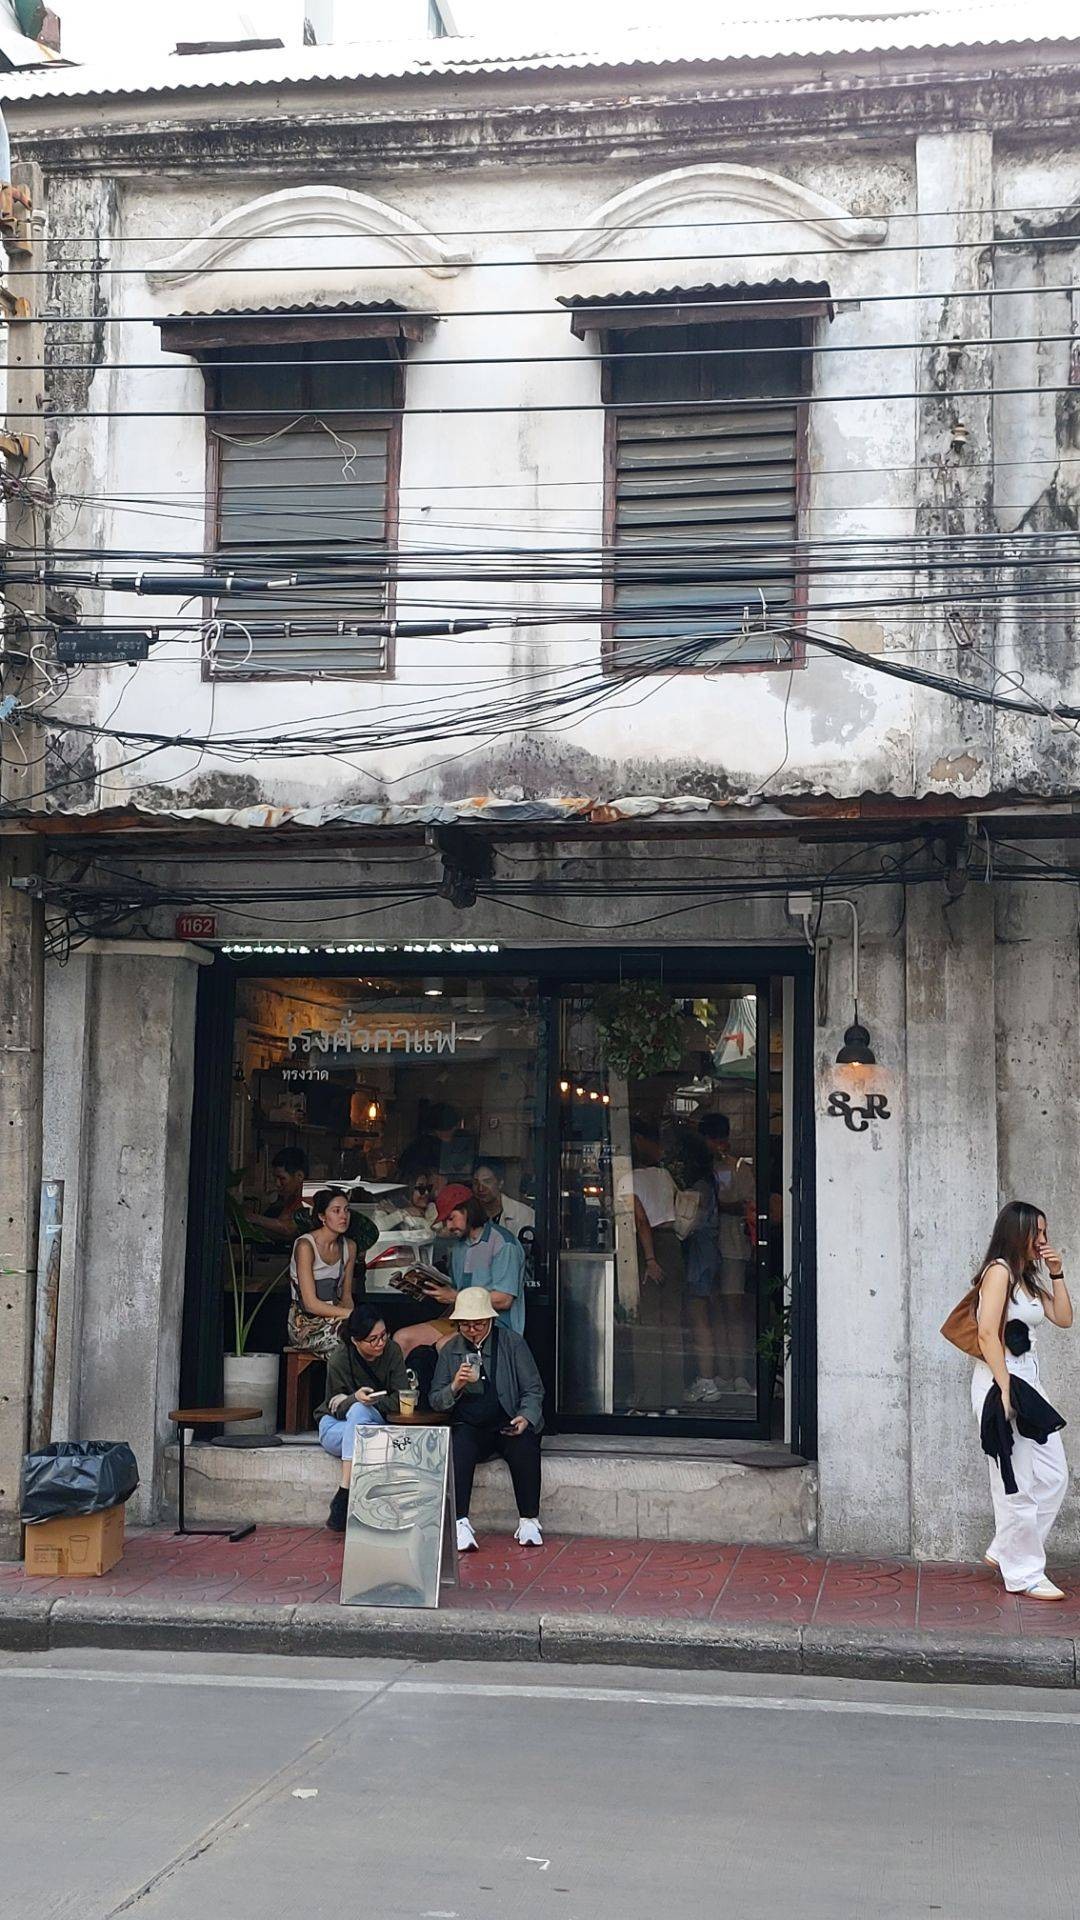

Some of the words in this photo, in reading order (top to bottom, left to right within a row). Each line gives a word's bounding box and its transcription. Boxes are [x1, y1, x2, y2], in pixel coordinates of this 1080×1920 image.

[181, 919, 213, 932] 1162
[286, 1009, 457, 1054] โรงคั่วกาแฟ
[282, 1068, 330, 1081] ทรงวาด
[828, 1091, 891, 1132] SCR
